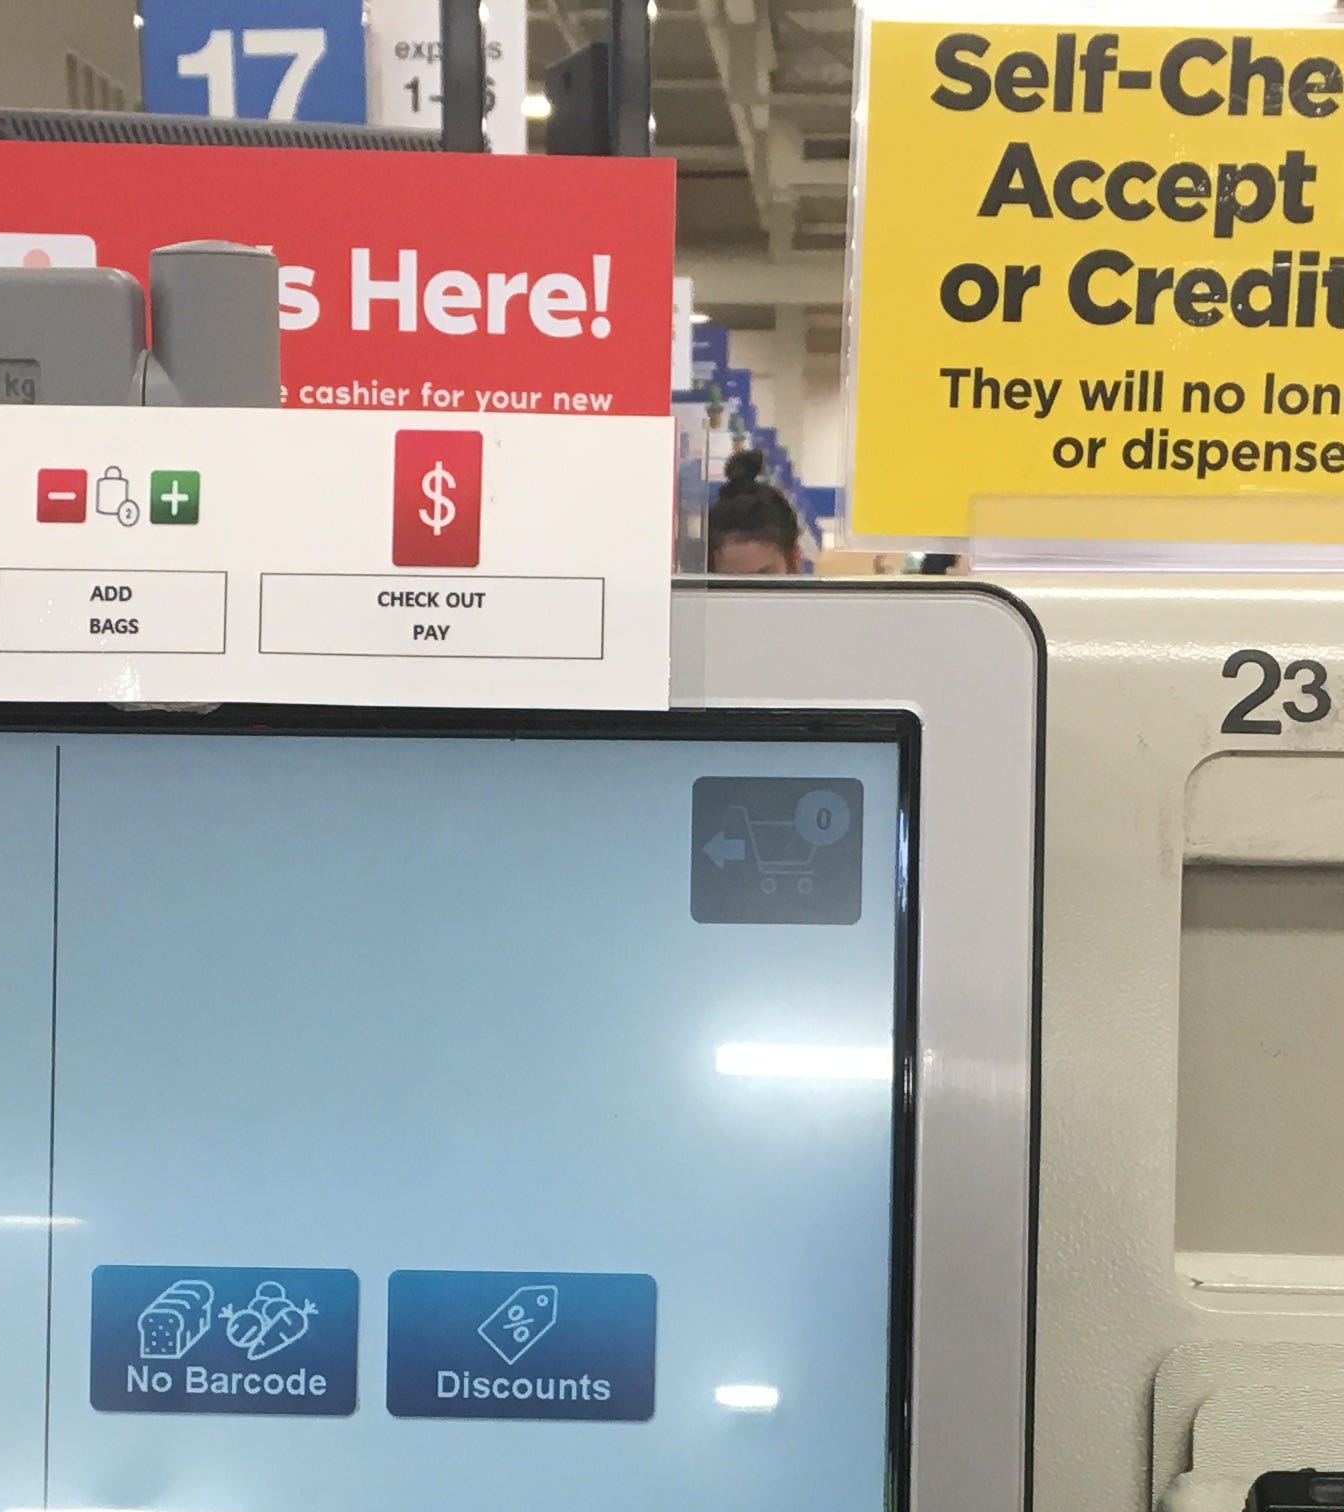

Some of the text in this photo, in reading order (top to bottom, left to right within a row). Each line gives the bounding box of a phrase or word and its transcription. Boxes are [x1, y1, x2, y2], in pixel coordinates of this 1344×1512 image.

[177, 28, 327, 122] 17
[977, 141, 1317, 239] Accept
[351, 247, 612, 339] Here!
[940, 262, 1041, 323] or
[299, 380, 410, 406] cashier
[421, 381, 464, 407] for
[475, 388, 542, 413] your
[553, 389, 613, 412] new
[939, 367, 1062, 419] They
[1079, 370, 1163, 413] will
[1182, 381, 1245, 415] no
[1052, 434, 1106, 470] or
[90, 586, 133, 603] ADD
[377, 591, 486, 610] CHECK OUT
[89, 617, 139, 636] BAGS
[412, 625, 451, 642] PAY
[1221, 649, 1332, 735] 23
[815, 807, 832, 831] 0
[126, 1365, 327, 1396] No Barcode
[437, 1371, 611, 1401] Discounts
